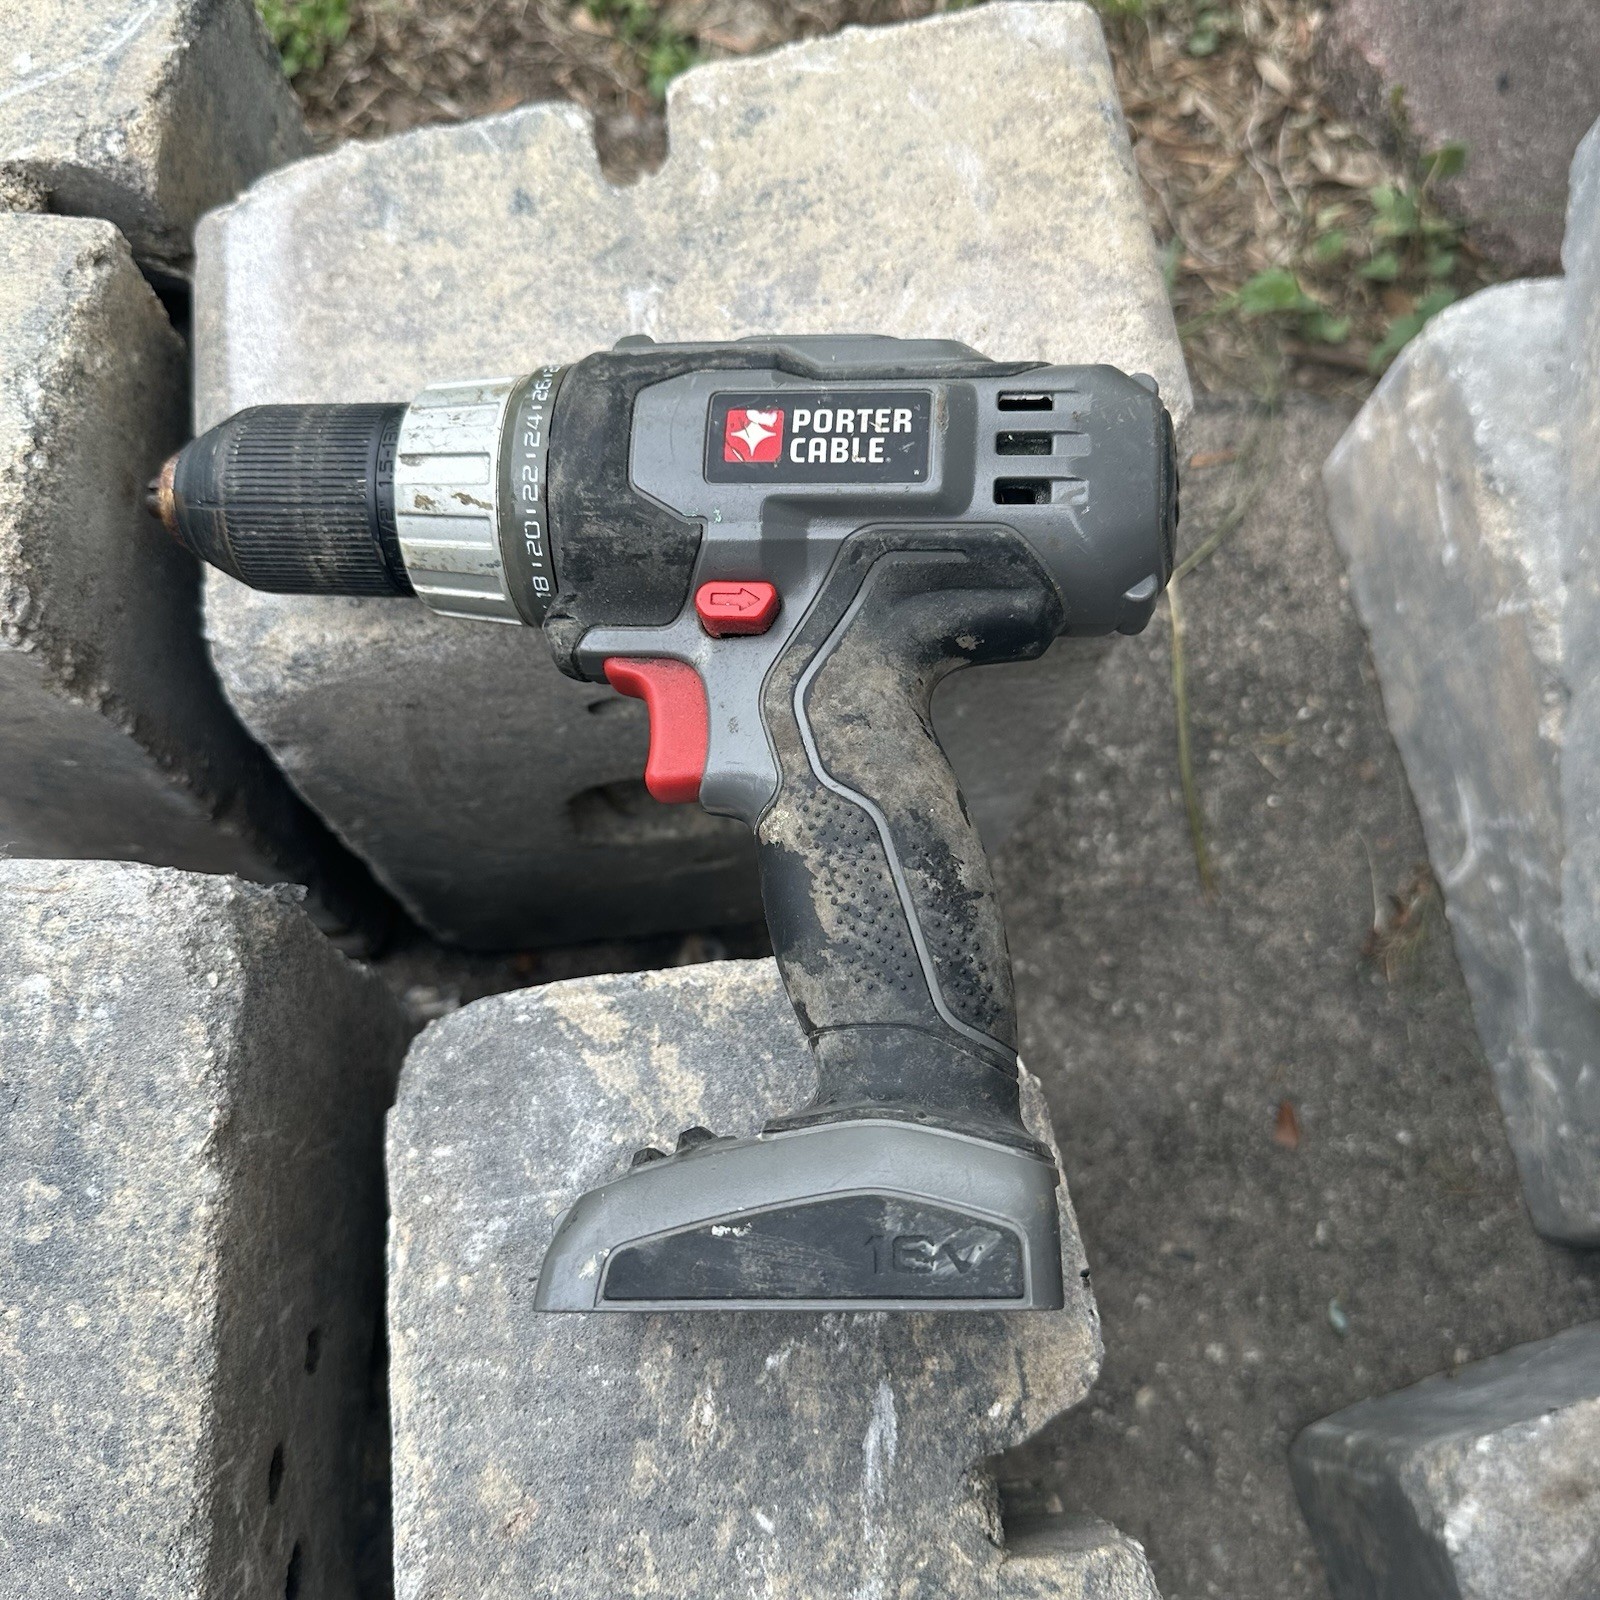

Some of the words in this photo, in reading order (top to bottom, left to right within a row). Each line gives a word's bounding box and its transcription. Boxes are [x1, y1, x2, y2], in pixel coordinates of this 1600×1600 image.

[532, 379, 553, 401] 26
[524, 413, 543, 447] 24
[791, 408, 912, 434] PORTER
[789, 437, 885, 464] CABLE
[522, 465, 539, 501] 22
[524, 520, 543, 557] 20
[532, 576, 552, 598] 18
